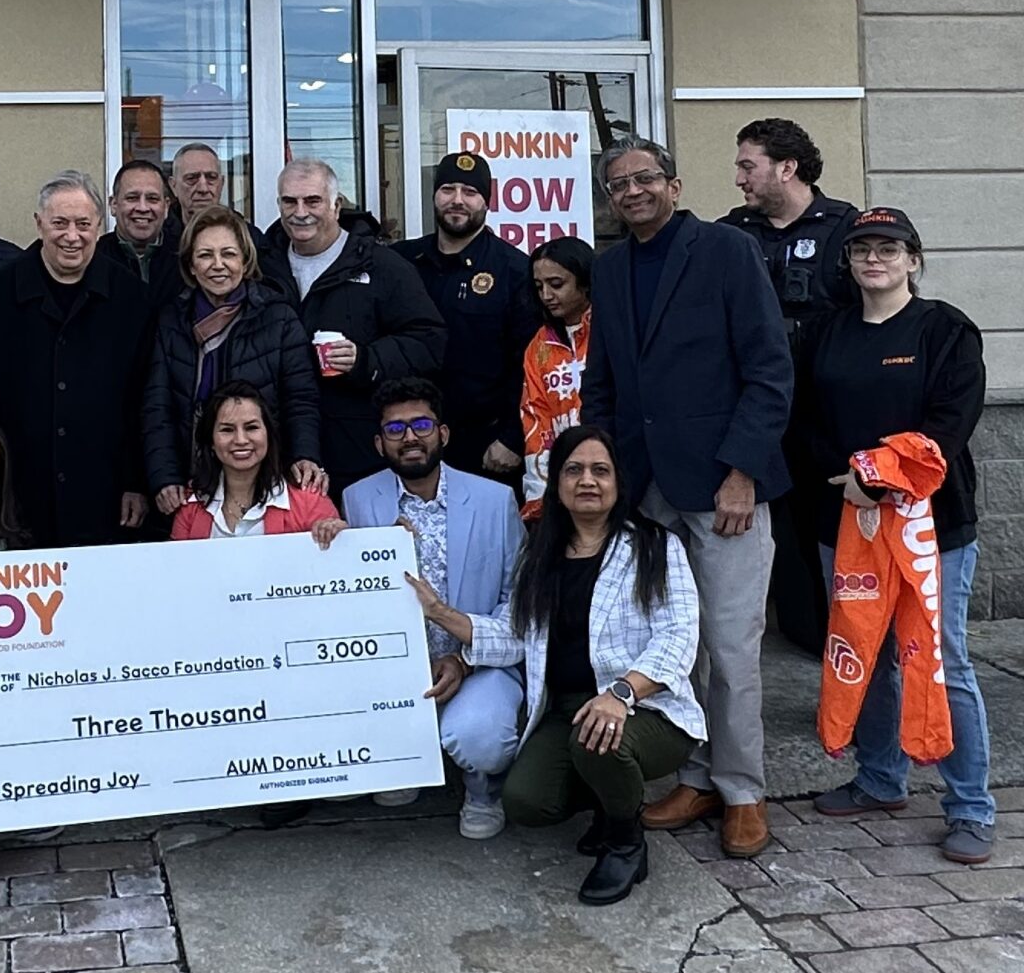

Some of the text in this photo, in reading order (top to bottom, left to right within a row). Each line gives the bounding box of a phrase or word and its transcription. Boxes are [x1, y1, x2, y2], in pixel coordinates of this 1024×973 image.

[460, 131, 579, 159] DUNKIN'
[361, 549, 397, 562] 0001
[229, 576, 391, 602] DATE January 23, 2026
[12, 640, 65, 651] FOUNDATION
[317, 639, 378, 662] 3,000
[1, 673, 21, 681] THE
[28, 655, 282, 688] Nicholas J. Sacco Foundation $
[0, 684, 15, 692] OF
[372, 699, 415, 711] DOLLARS
[72, 700, 267, 737] Three Thousand
[226, 757, 268, 777] AUM
[337, 747, 372, 765] LLC
[2, 775, 101, 801] Spreading
[107, 772, 140, 789] Joy
[259, 775, 349, 790] AUTHORIZED SIGNATURE
